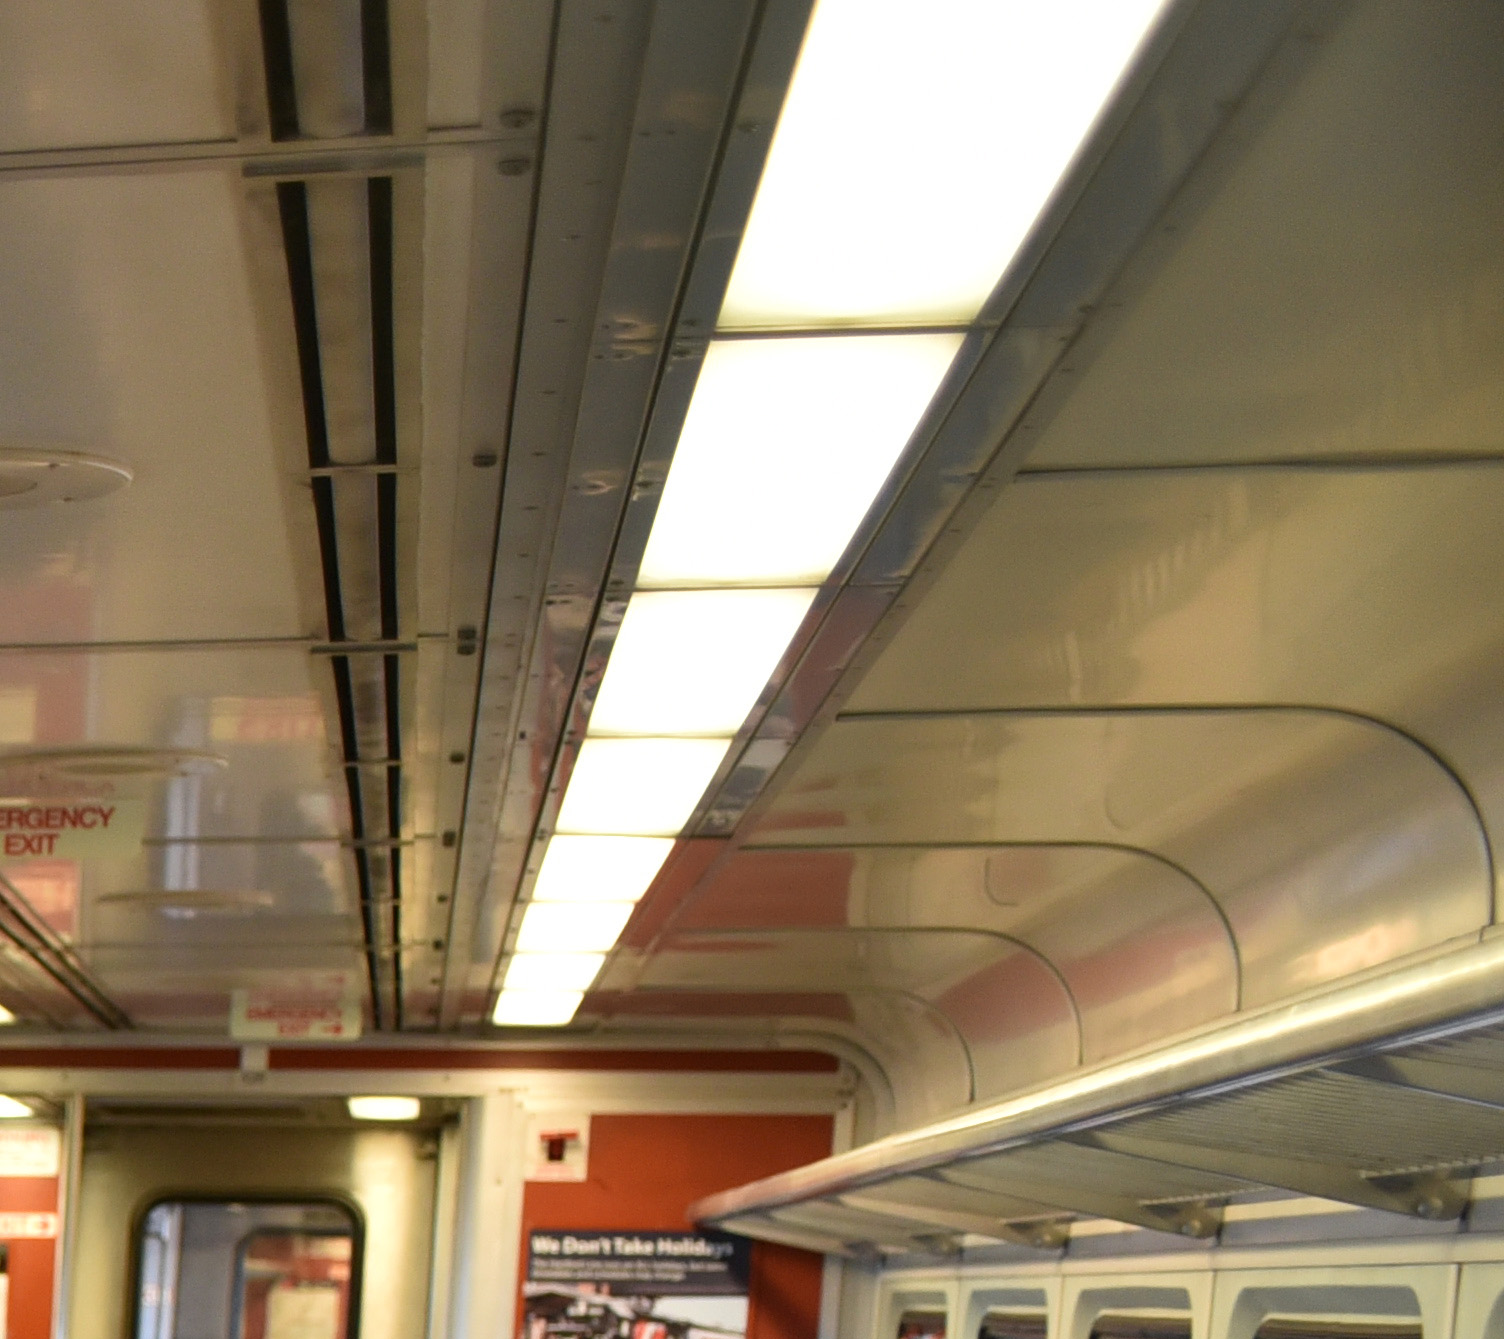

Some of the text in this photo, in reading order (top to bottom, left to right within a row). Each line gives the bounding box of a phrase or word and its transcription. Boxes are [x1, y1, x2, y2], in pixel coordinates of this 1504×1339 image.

[3, 832, 61, 856] EXIT
[531, 1235, 734, 1260] We Don't Take Holidays
